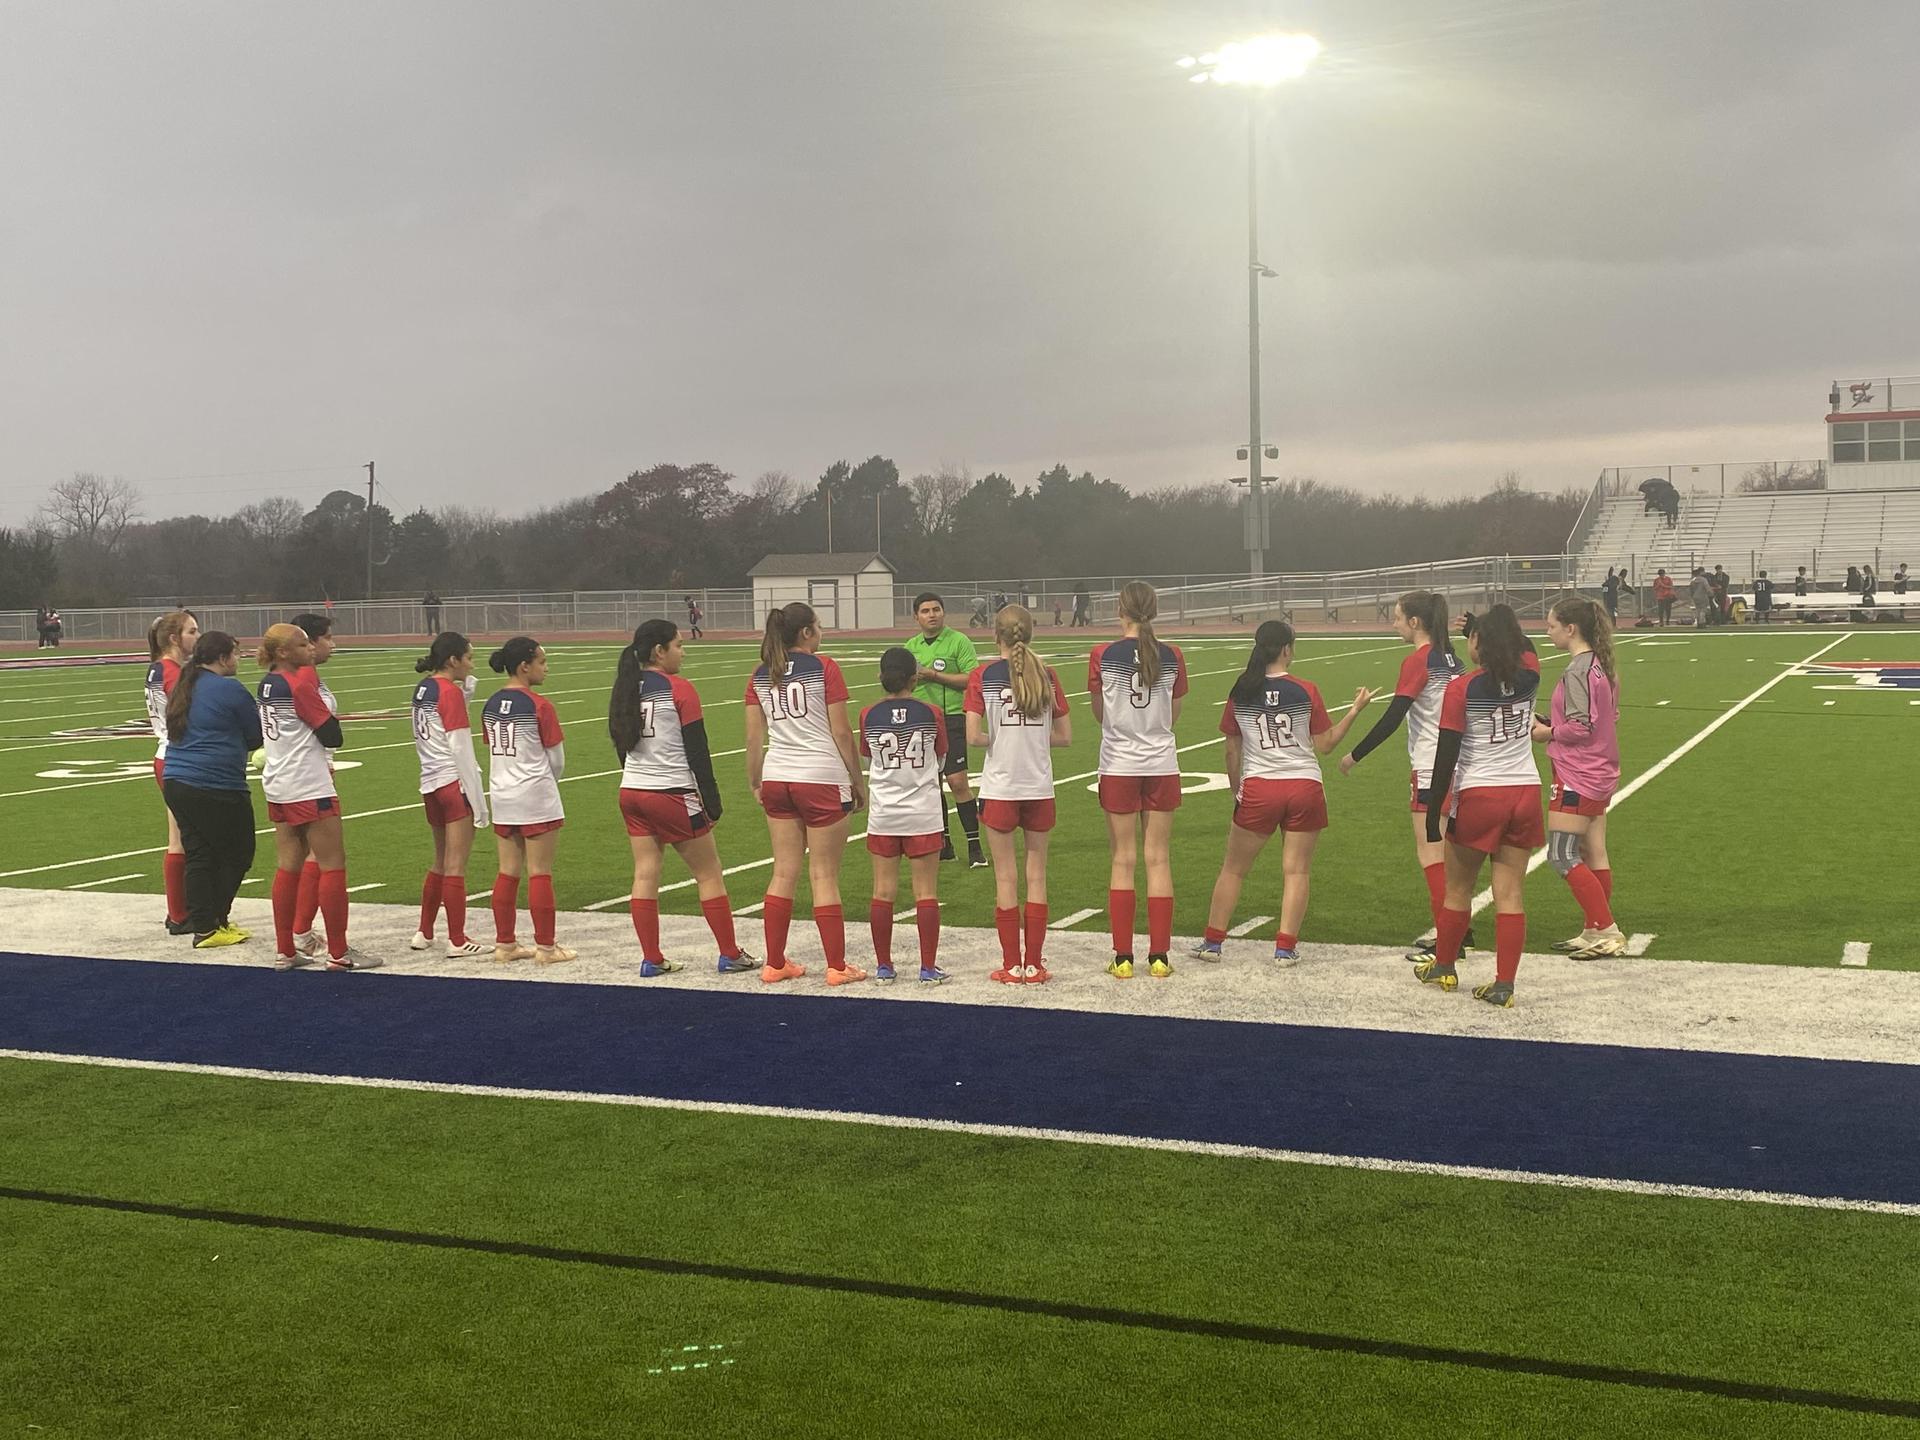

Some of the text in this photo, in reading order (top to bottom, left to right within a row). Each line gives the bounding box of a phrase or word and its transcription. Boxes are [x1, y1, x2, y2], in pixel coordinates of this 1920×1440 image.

[768, 680, 808, 721] 10
[1129, 671, 1151, 709] 9
[491, 720, 517, 758] 11
[1255, 712, 1300, 750] 12
[1490, 700, 1532, 744] 17
[878, 728, 925, 770] 24
